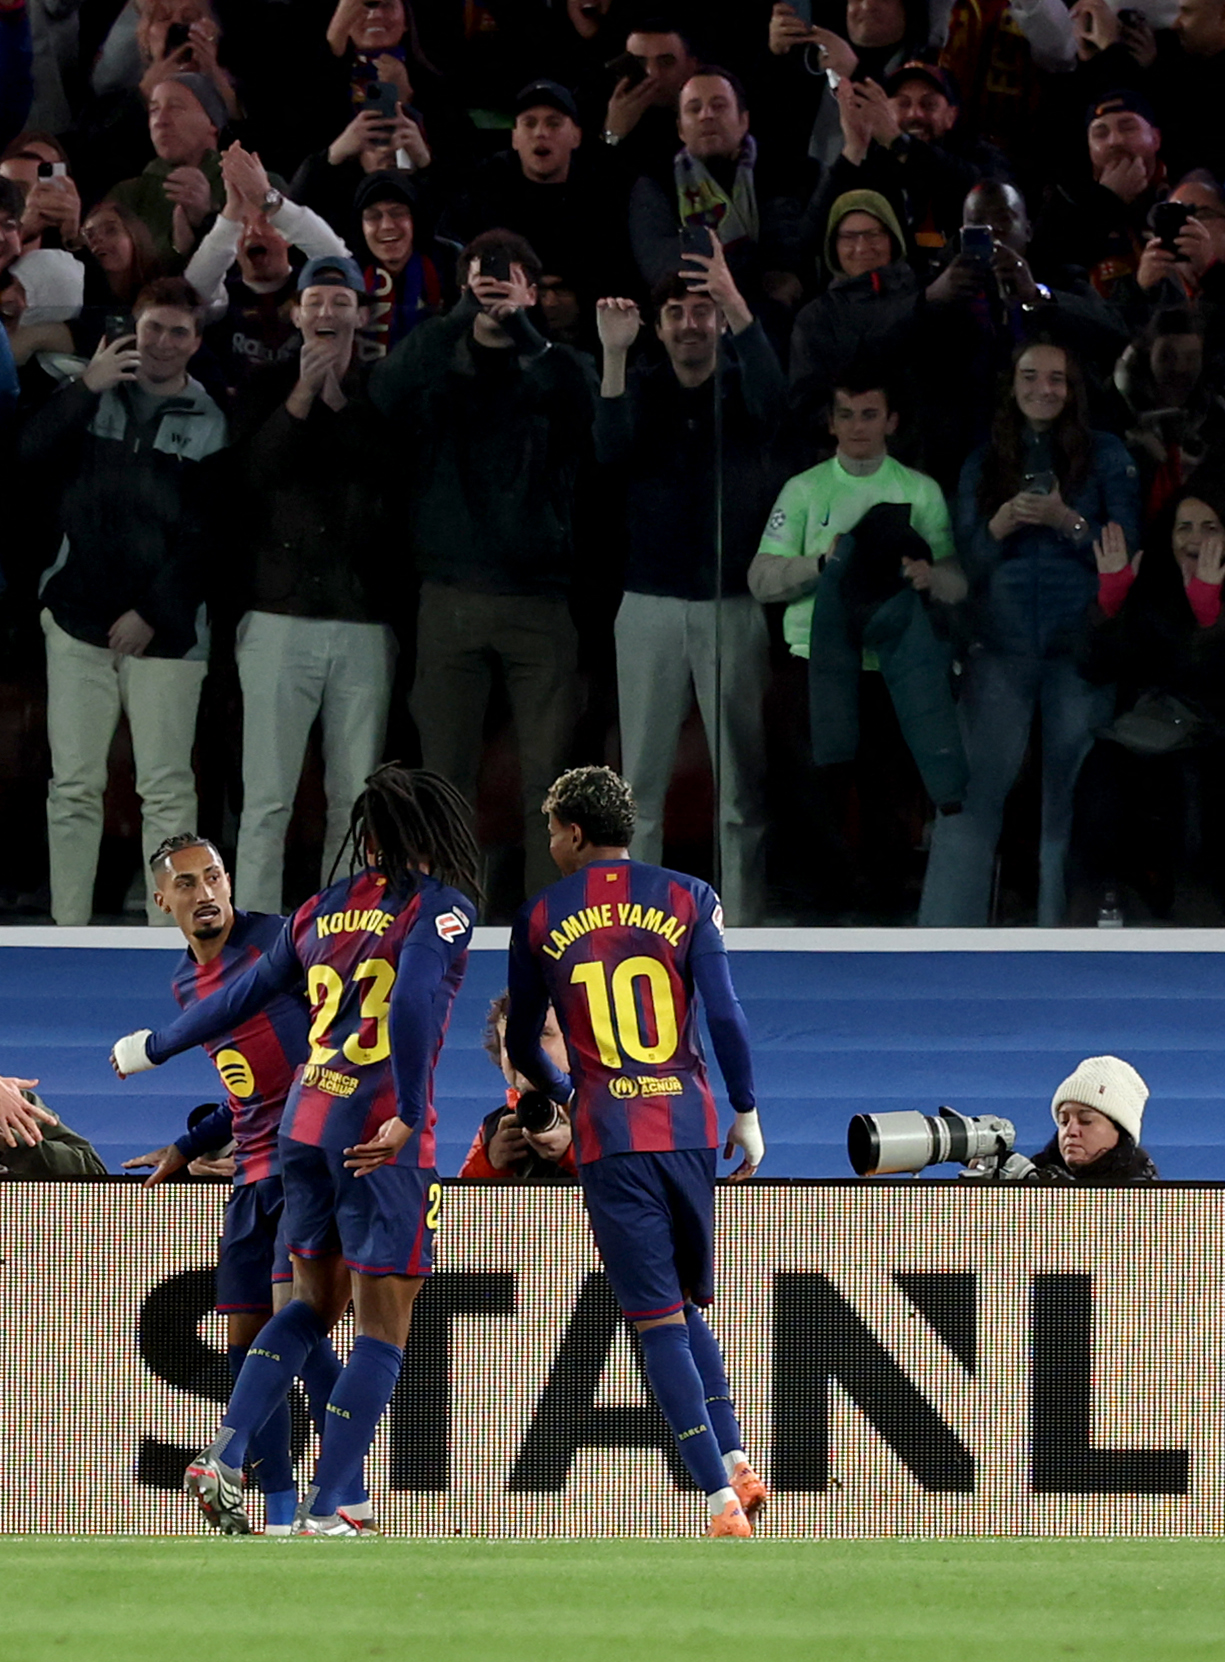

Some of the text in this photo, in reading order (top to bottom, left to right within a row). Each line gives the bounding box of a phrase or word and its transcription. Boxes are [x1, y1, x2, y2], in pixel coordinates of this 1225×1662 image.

[542, 902, 687, 960] LAMINE YAMAL
[306, 958, 396, 1066] 23
[570, 955, 678, 1069] 10
[317, 1079, 356, 1096] ACNUR
[320, 1067, 360, 1089] UNHCR
[641, 1082, 683, 1094] ACNUR
